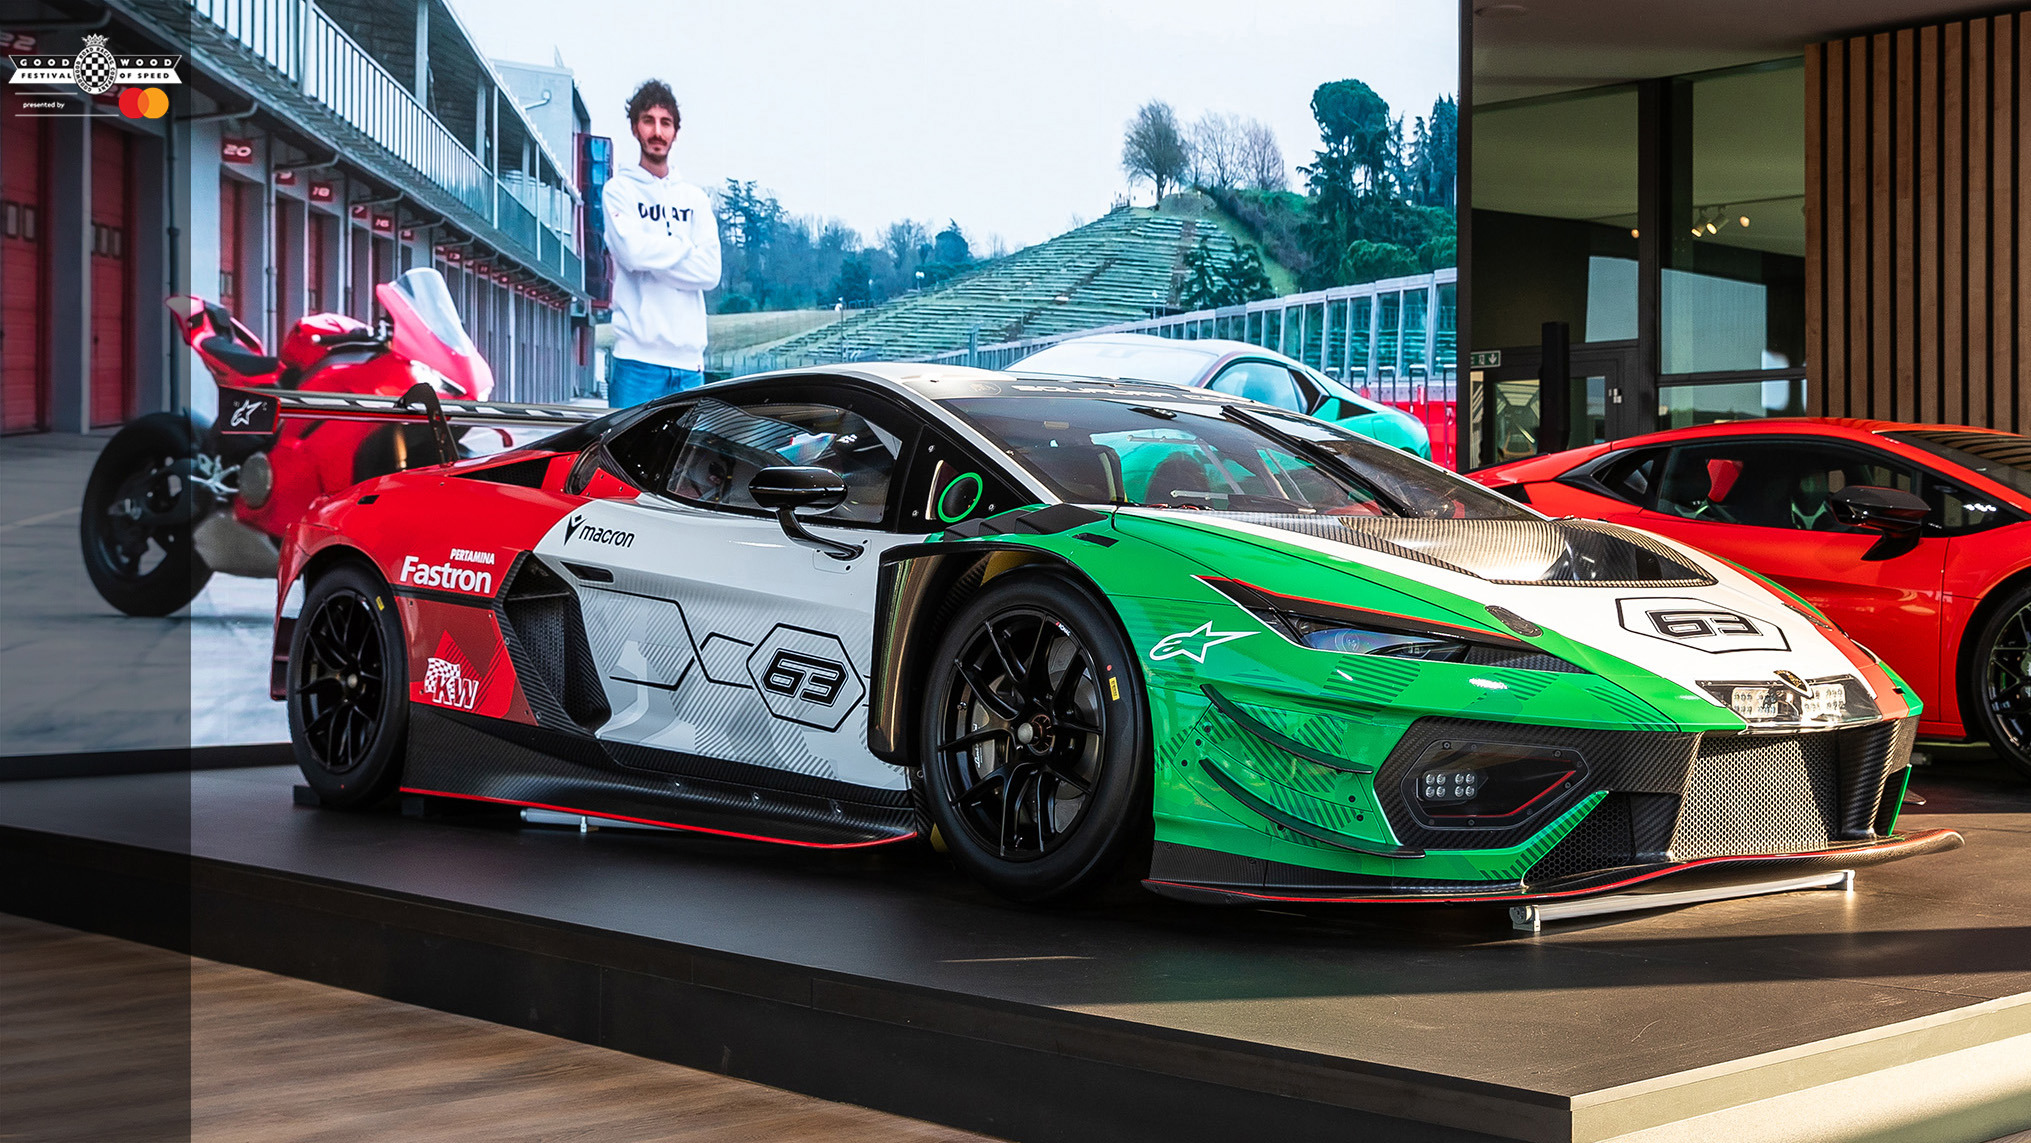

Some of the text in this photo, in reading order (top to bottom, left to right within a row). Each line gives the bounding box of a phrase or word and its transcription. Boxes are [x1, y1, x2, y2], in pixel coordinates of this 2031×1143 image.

[223, 143, 252, 157] 20
[578, 525, 636, 549] macron
[449, 548, 496, 565] PERTAMINA
[399, 555, 493, 594] Fastron
[1645, 610, 1764, 640] 63
[432, 673, 480, 710] KW
[761, 647, 849, 708] 63
